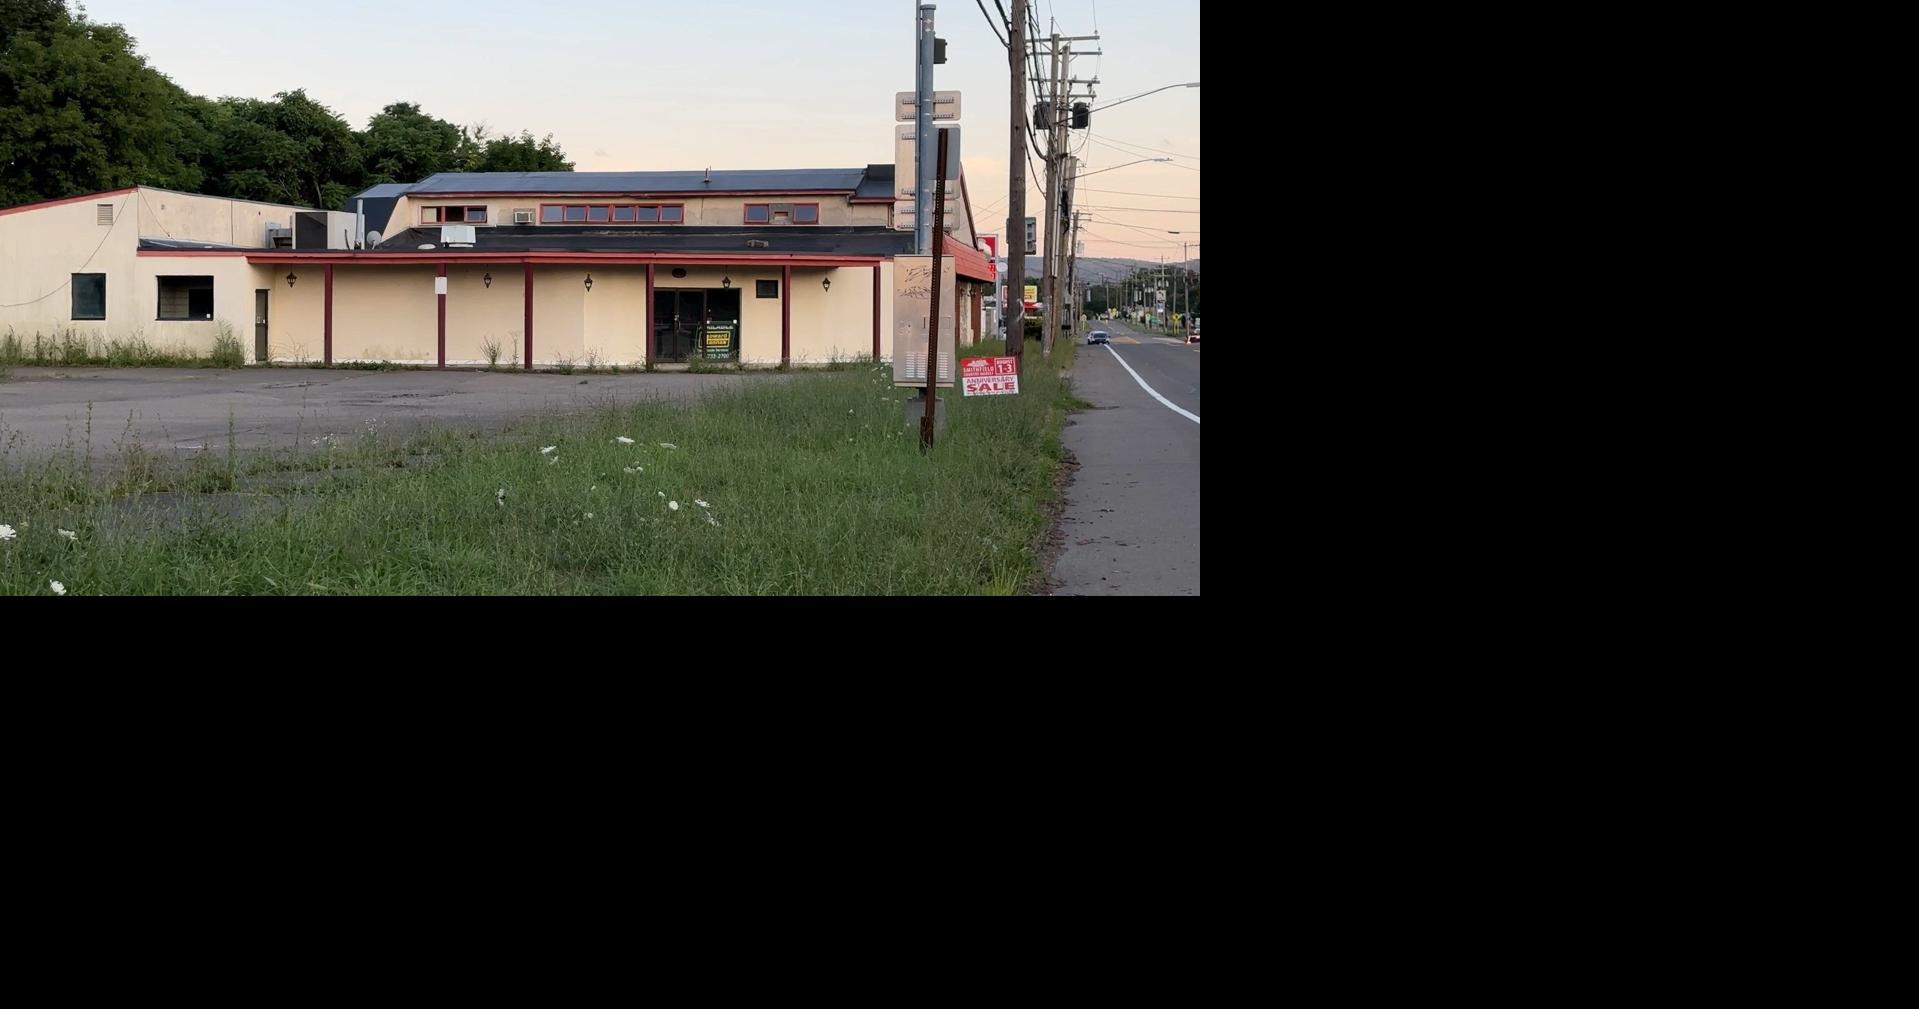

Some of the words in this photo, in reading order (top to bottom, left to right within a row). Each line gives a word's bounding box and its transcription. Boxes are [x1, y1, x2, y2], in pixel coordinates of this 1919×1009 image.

[998, 364, 1013, 373] 1-3
[966, 376, 1013, 384] ANNIVERSARY
[967, 382, 1015, 392] SALE
